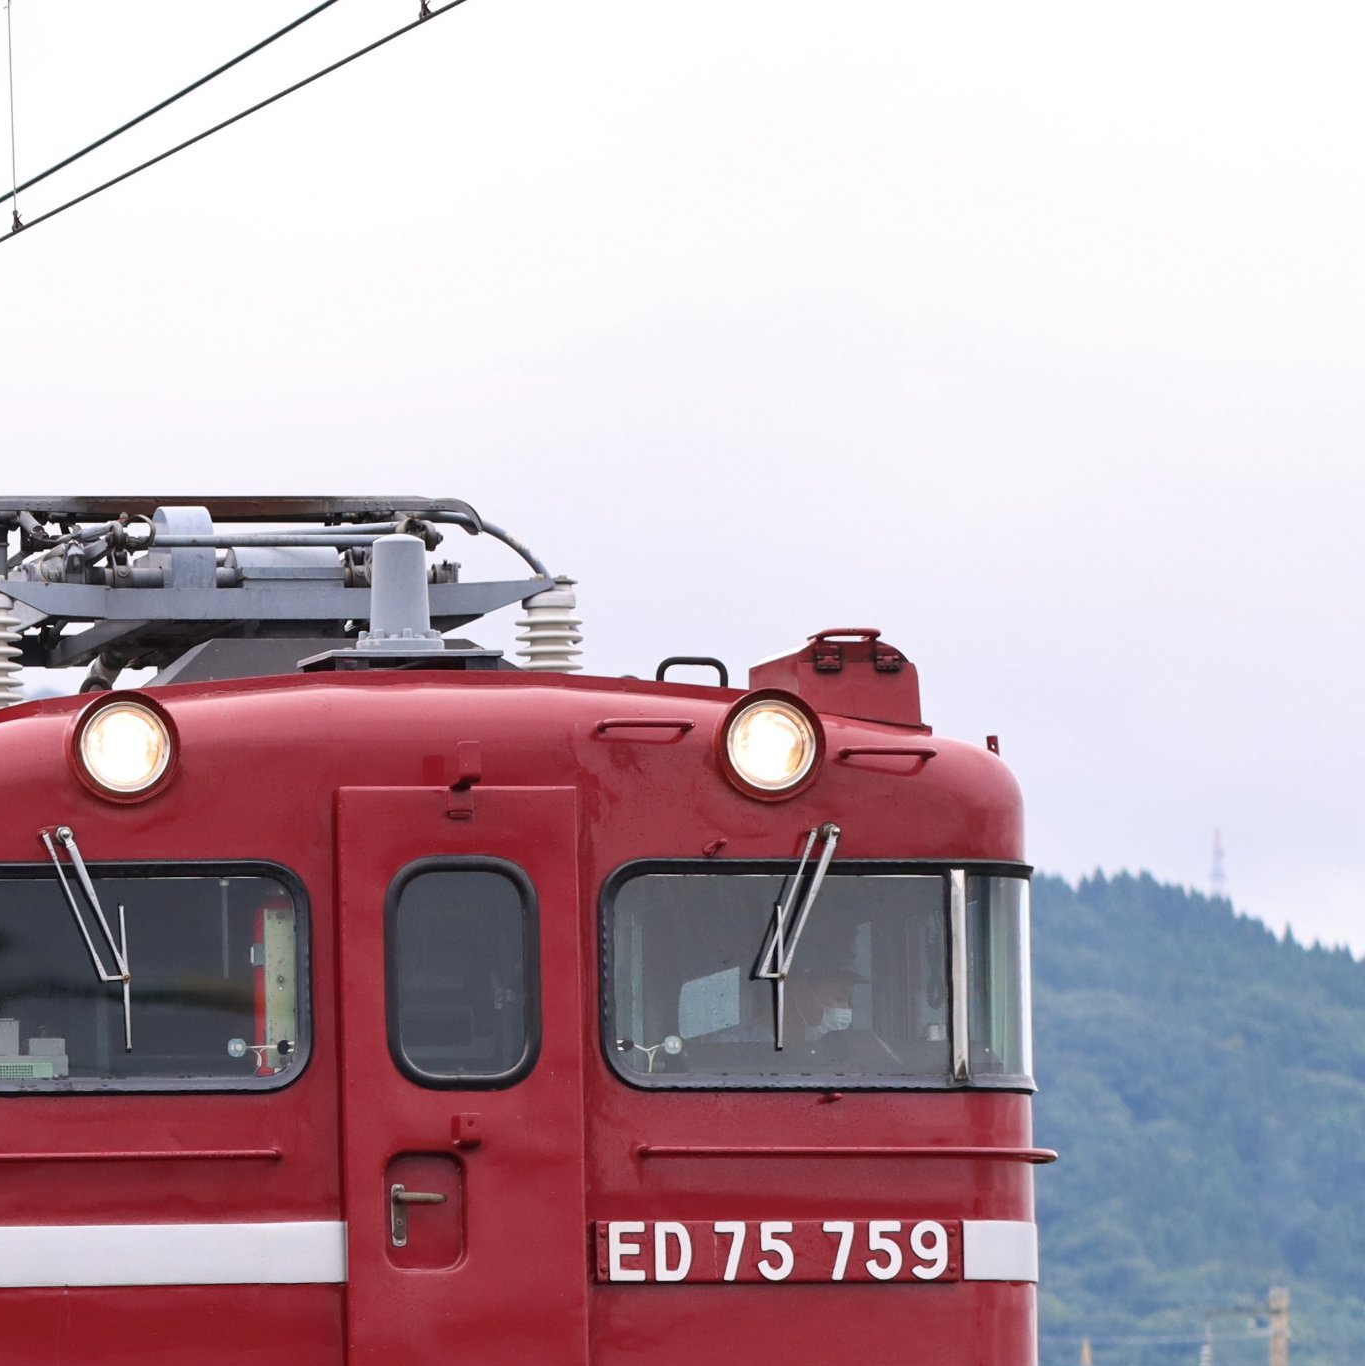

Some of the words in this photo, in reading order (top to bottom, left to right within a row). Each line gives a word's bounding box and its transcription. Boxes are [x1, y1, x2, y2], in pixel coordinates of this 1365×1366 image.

[607, 1220, 693, 1282] ED
[713, 1220, 795, 1282] 75
[822, 1220, 949, 1281] 759
